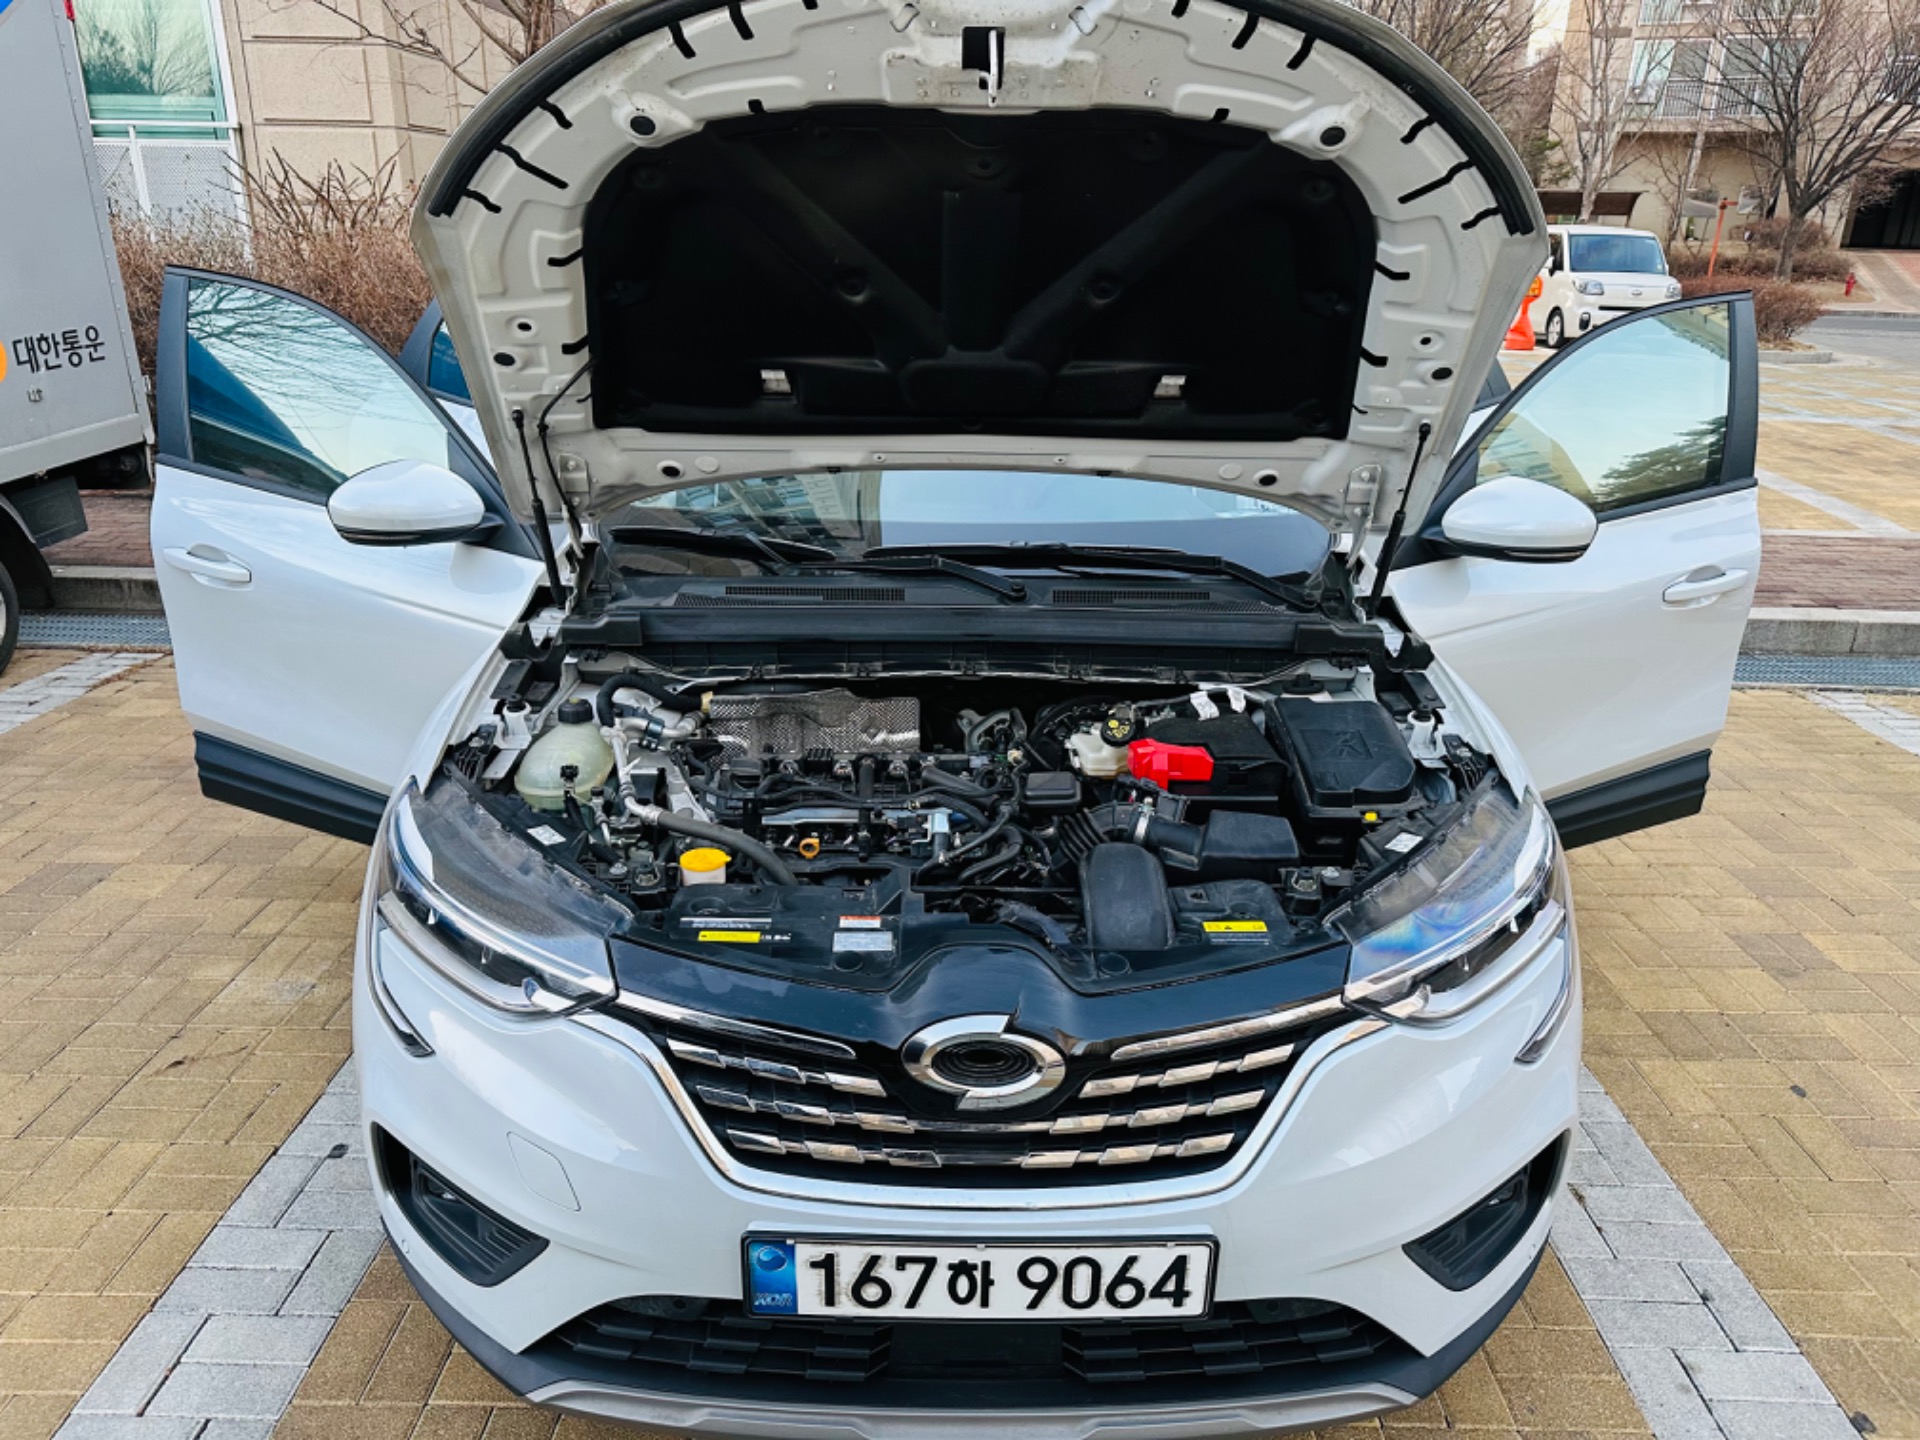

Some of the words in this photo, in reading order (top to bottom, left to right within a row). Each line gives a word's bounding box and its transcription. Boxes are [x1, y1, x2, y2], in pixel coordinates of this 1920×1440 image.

[12, 325, 105, 373] 대한통운
[809, 1252, 994, 1309] 167하
[1017, 1254, 1191, 1309] 9064
